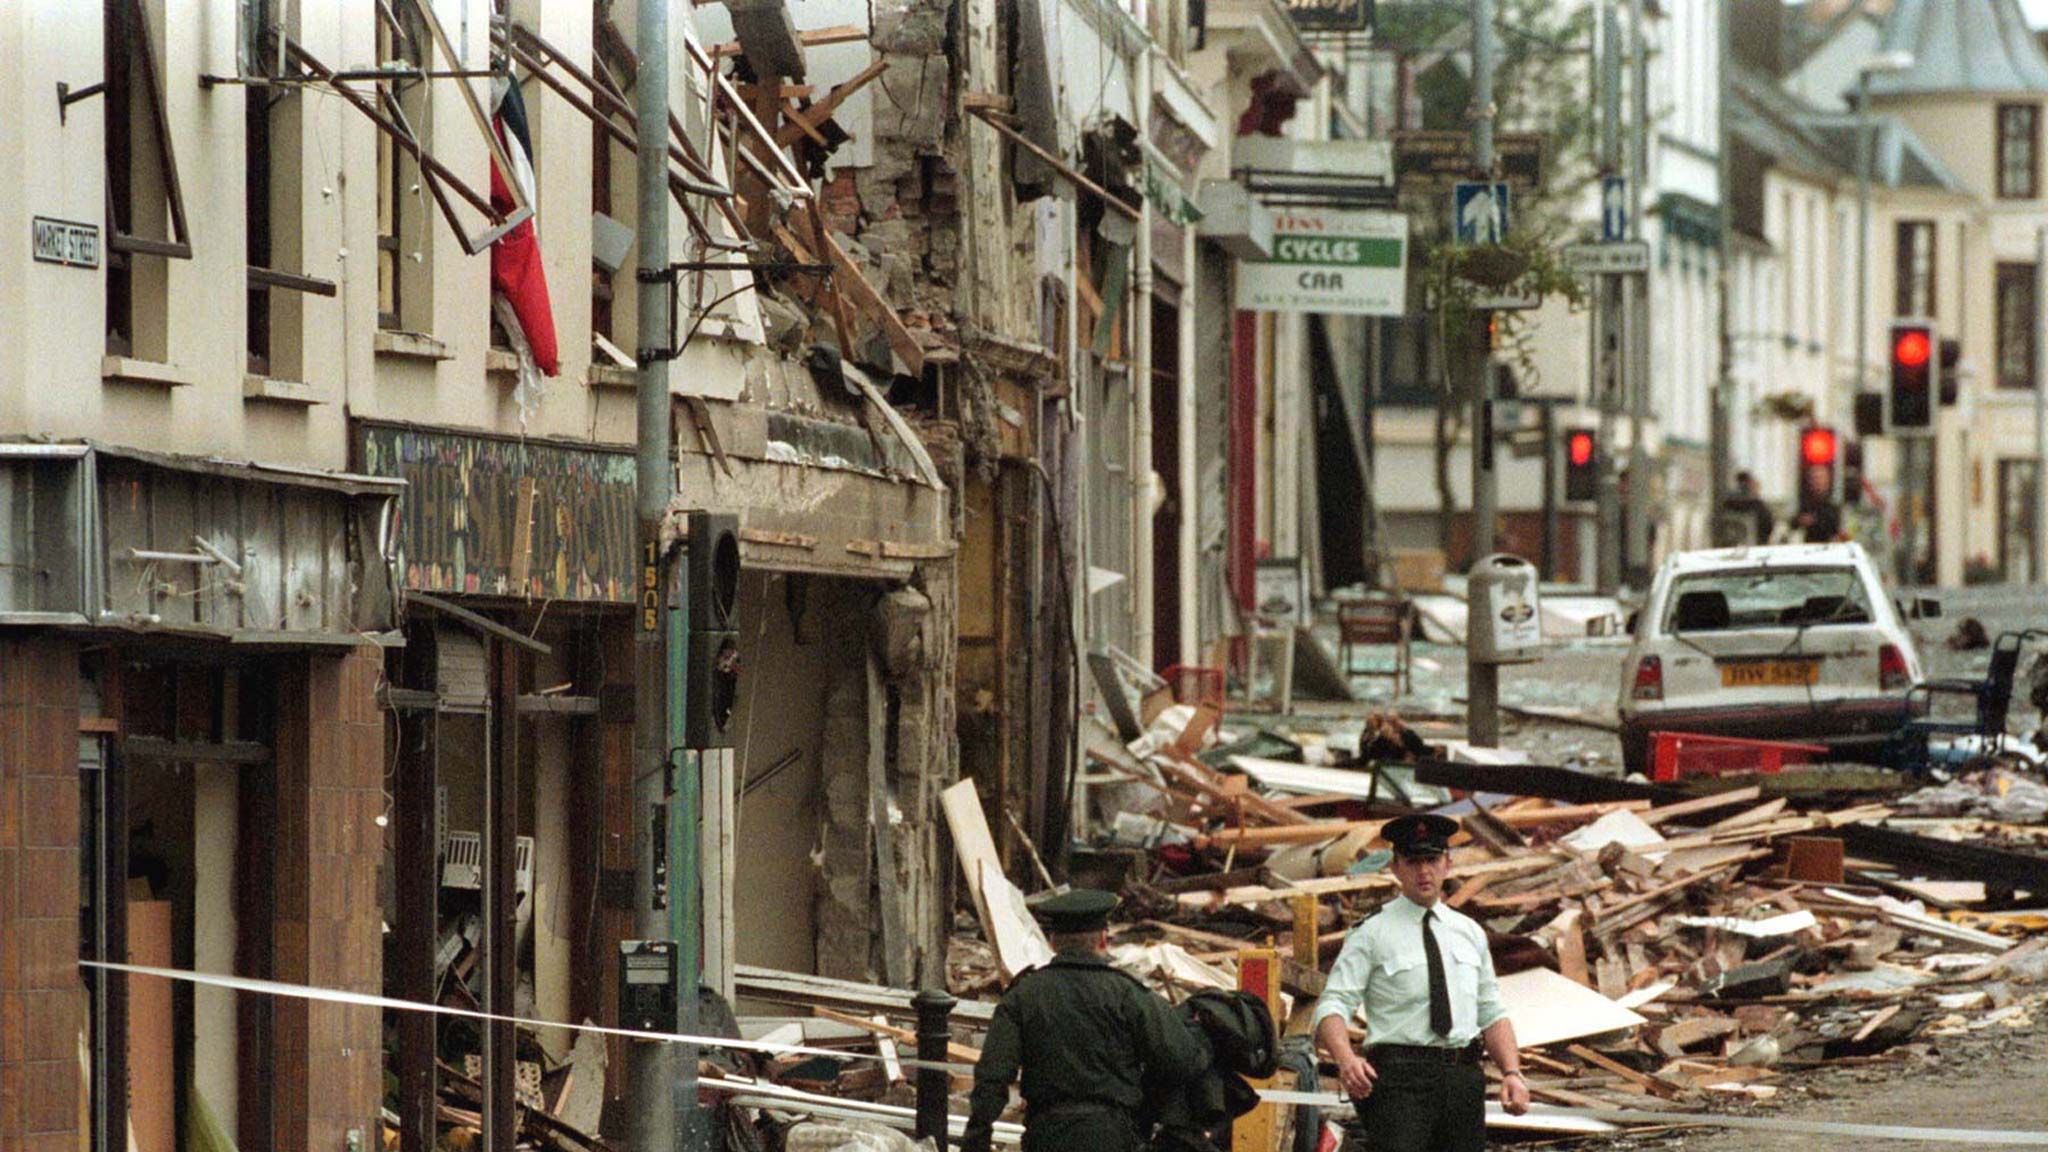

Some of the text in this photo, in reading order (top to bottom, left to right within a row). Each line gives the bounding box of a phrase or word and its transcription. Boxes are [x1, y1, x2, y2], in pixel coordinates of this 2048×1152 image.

[36, 223, 98, 262] MARKET STREET
[1278, 240, 1361, 262] CYCLES
[1298, 271, 1343, 290] CAR
[643, 541, 659, 631] 1505
